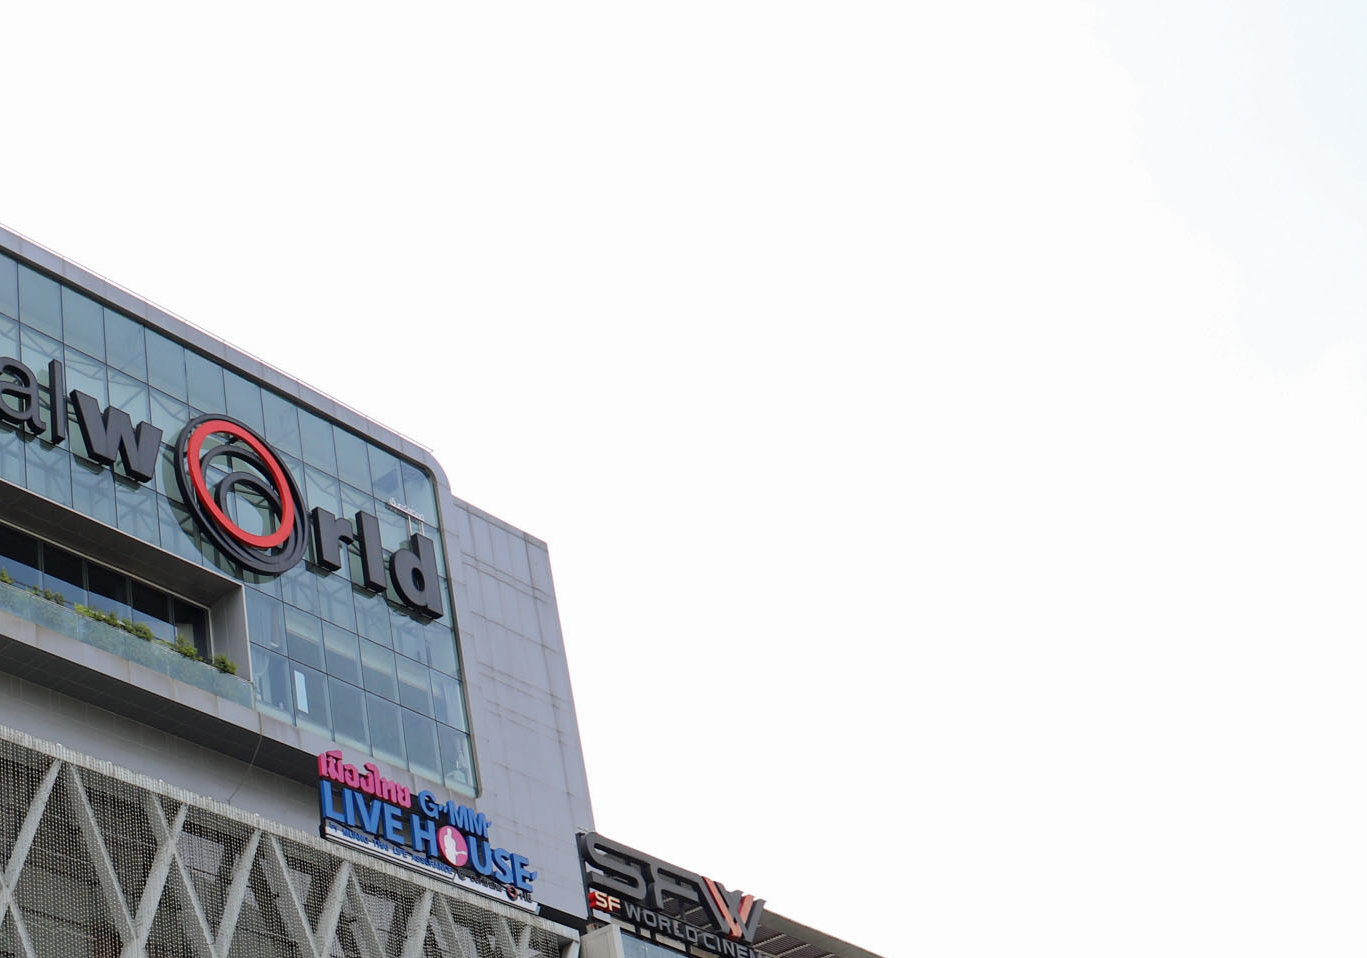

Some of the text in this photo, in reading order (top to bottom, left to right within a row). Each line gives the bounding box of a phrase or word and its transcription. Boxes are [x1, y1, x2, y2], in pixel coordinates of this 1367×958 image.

[320, 779, 406, 845] LIVE
[588, 890, 621, 912] SF
[624, 901, 699, 944] WORLD
